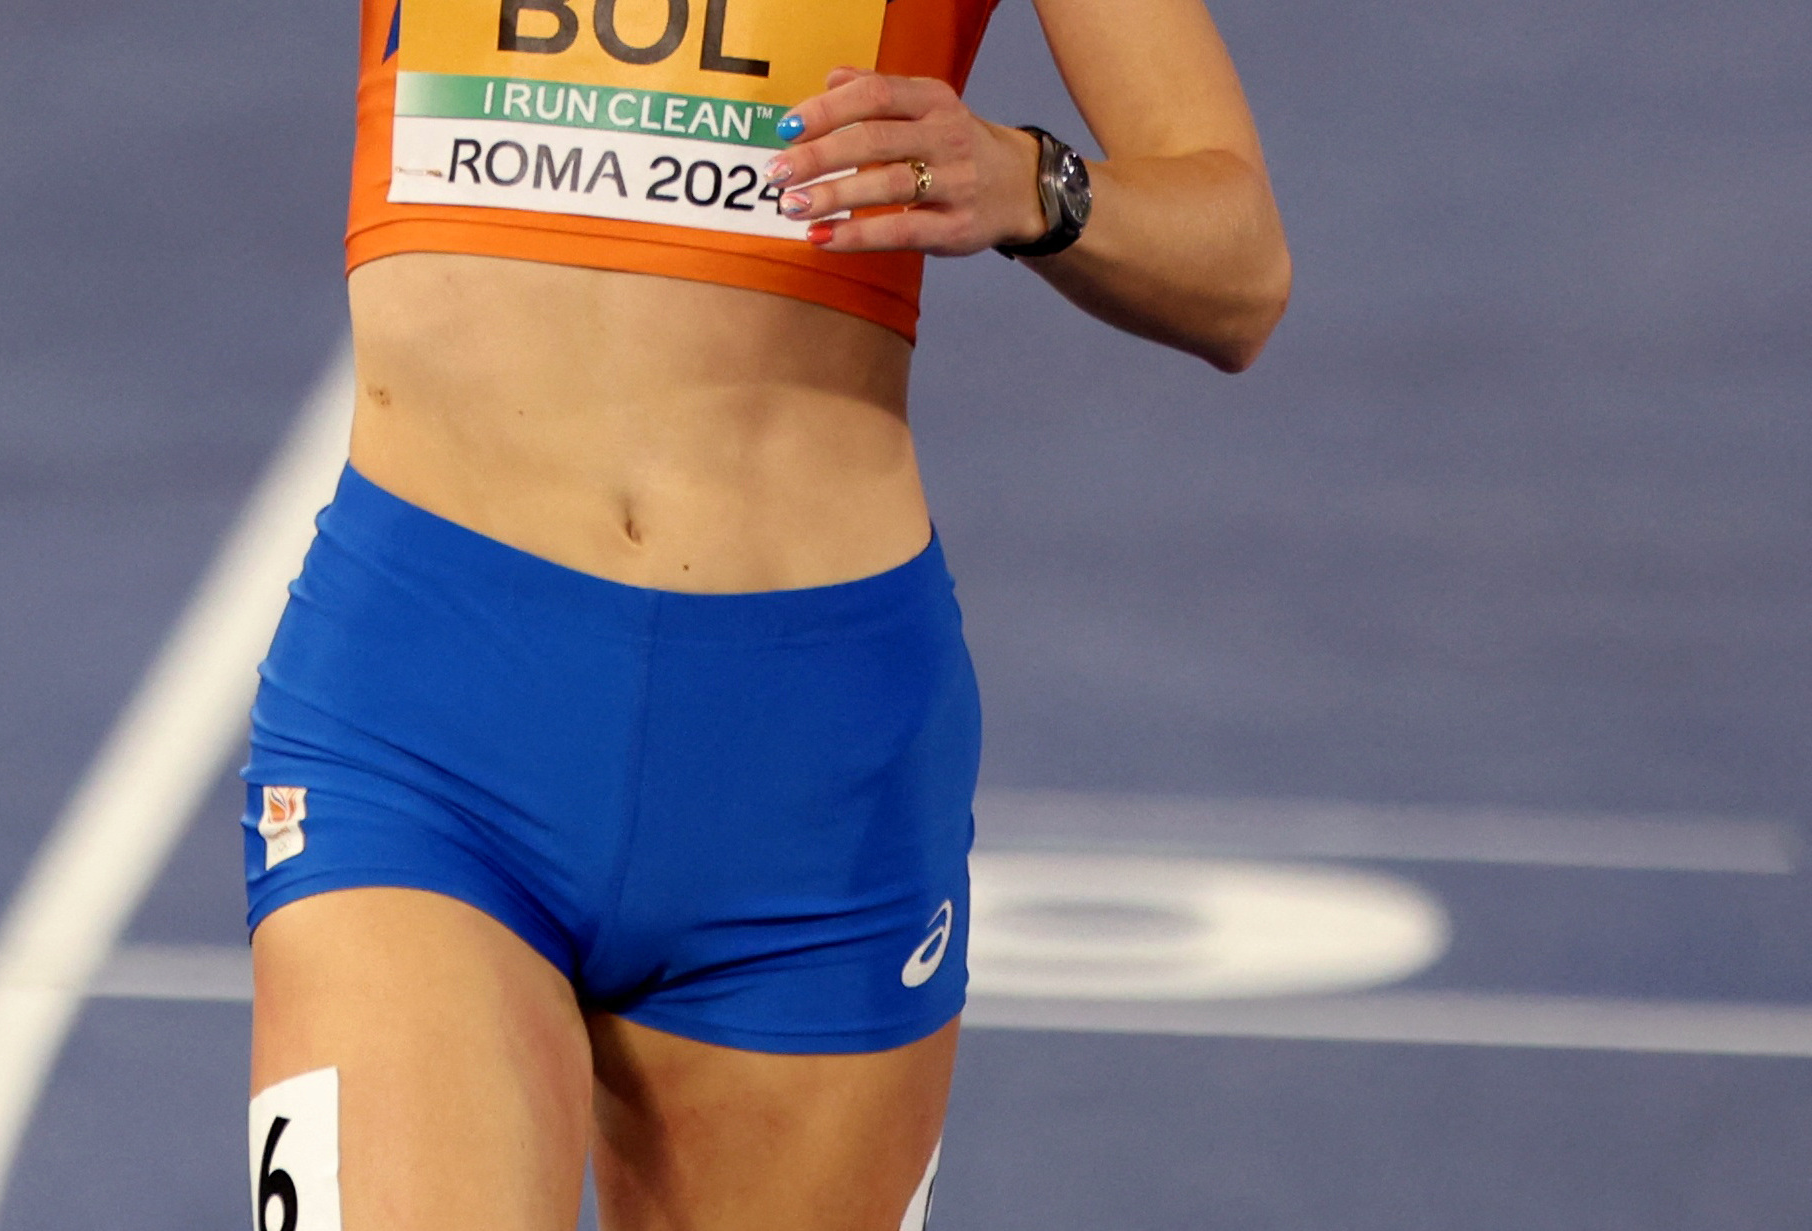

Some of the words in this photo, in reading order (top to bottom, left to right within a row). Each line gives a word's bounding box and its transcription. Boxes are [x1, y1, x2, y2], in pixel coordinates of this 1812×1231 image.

[483, 81, 494, 114] I
[503, 82, 598, 123] RUN
[448, 138, 628, 198] ROMA
[646, 155, 785, 215] 2024
[258, 1115, 298, 1231] 6
